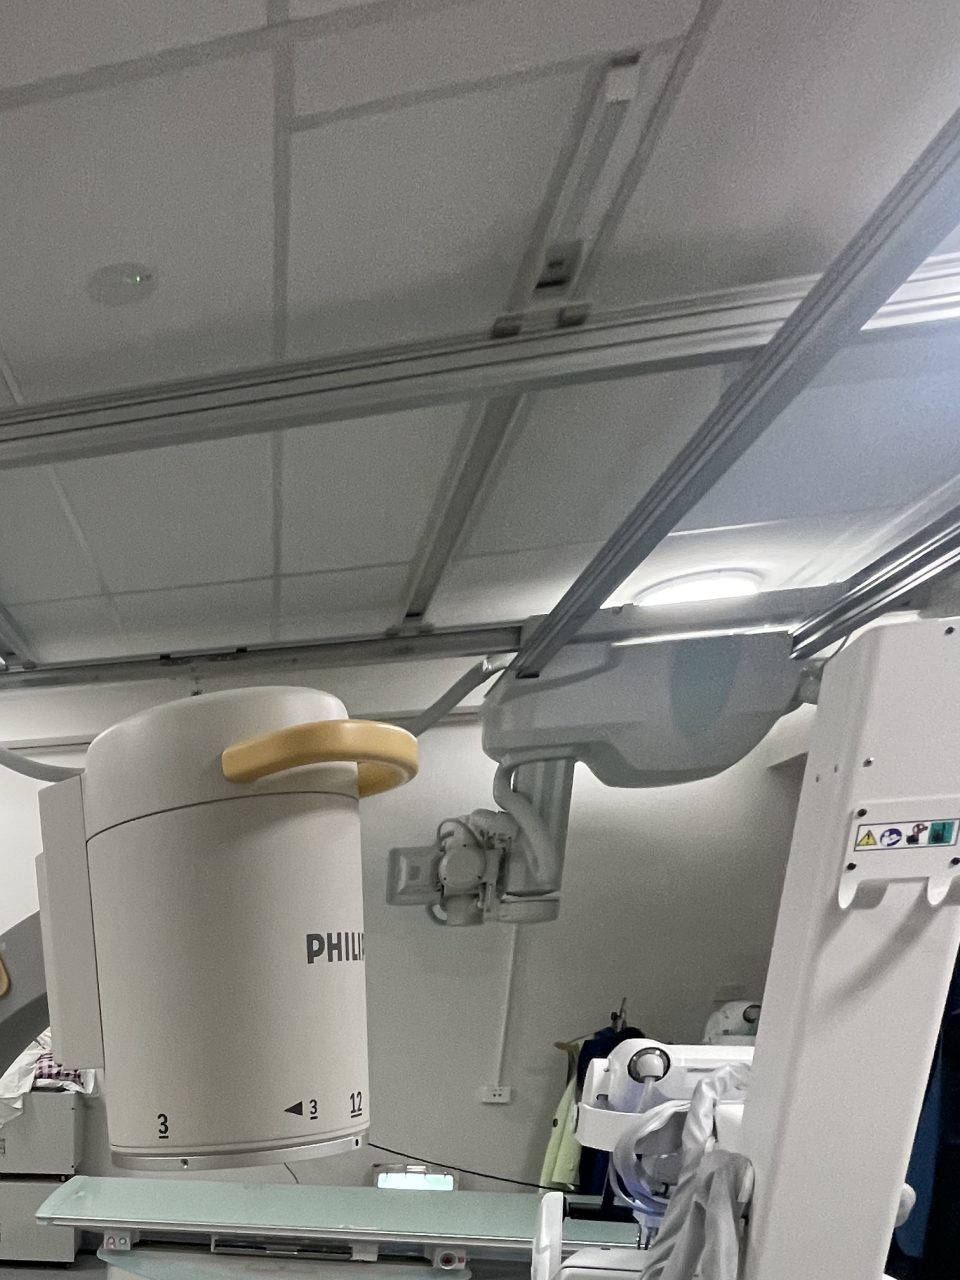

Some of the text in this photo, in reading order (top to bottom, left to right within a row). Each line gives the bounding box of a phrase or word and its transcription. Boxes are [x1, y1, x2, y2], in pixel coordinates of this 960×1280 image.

[309, 1099, 318, 1116] 3
[350, 1091, 362, 1114] 12
[157, 1113, 169, 1135] 3
